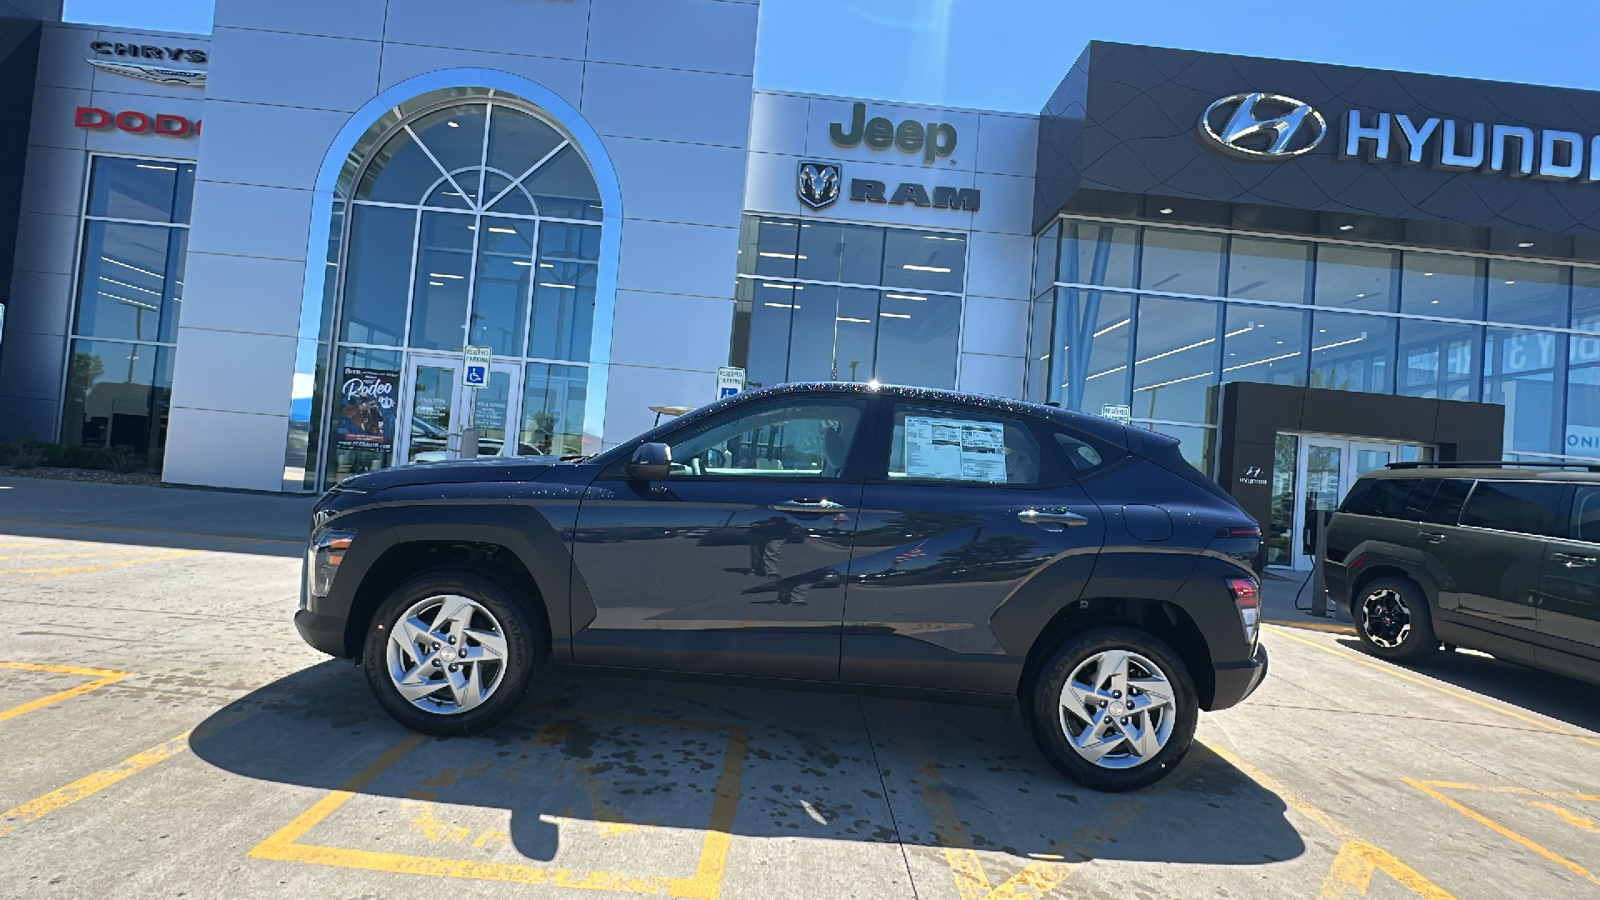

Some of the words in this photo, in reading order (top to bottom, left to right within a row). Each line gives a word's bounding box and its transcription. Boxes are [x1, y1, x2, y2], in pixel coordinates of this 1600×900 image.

[90, 41, 208, 63] CHRYS
[829, 102, 957, 165] Jeep
[1340, 109, 1600, 182] HYUND
[851, 178, 981, 211] RAM
[342, 378, 393, 401] Rodeo
